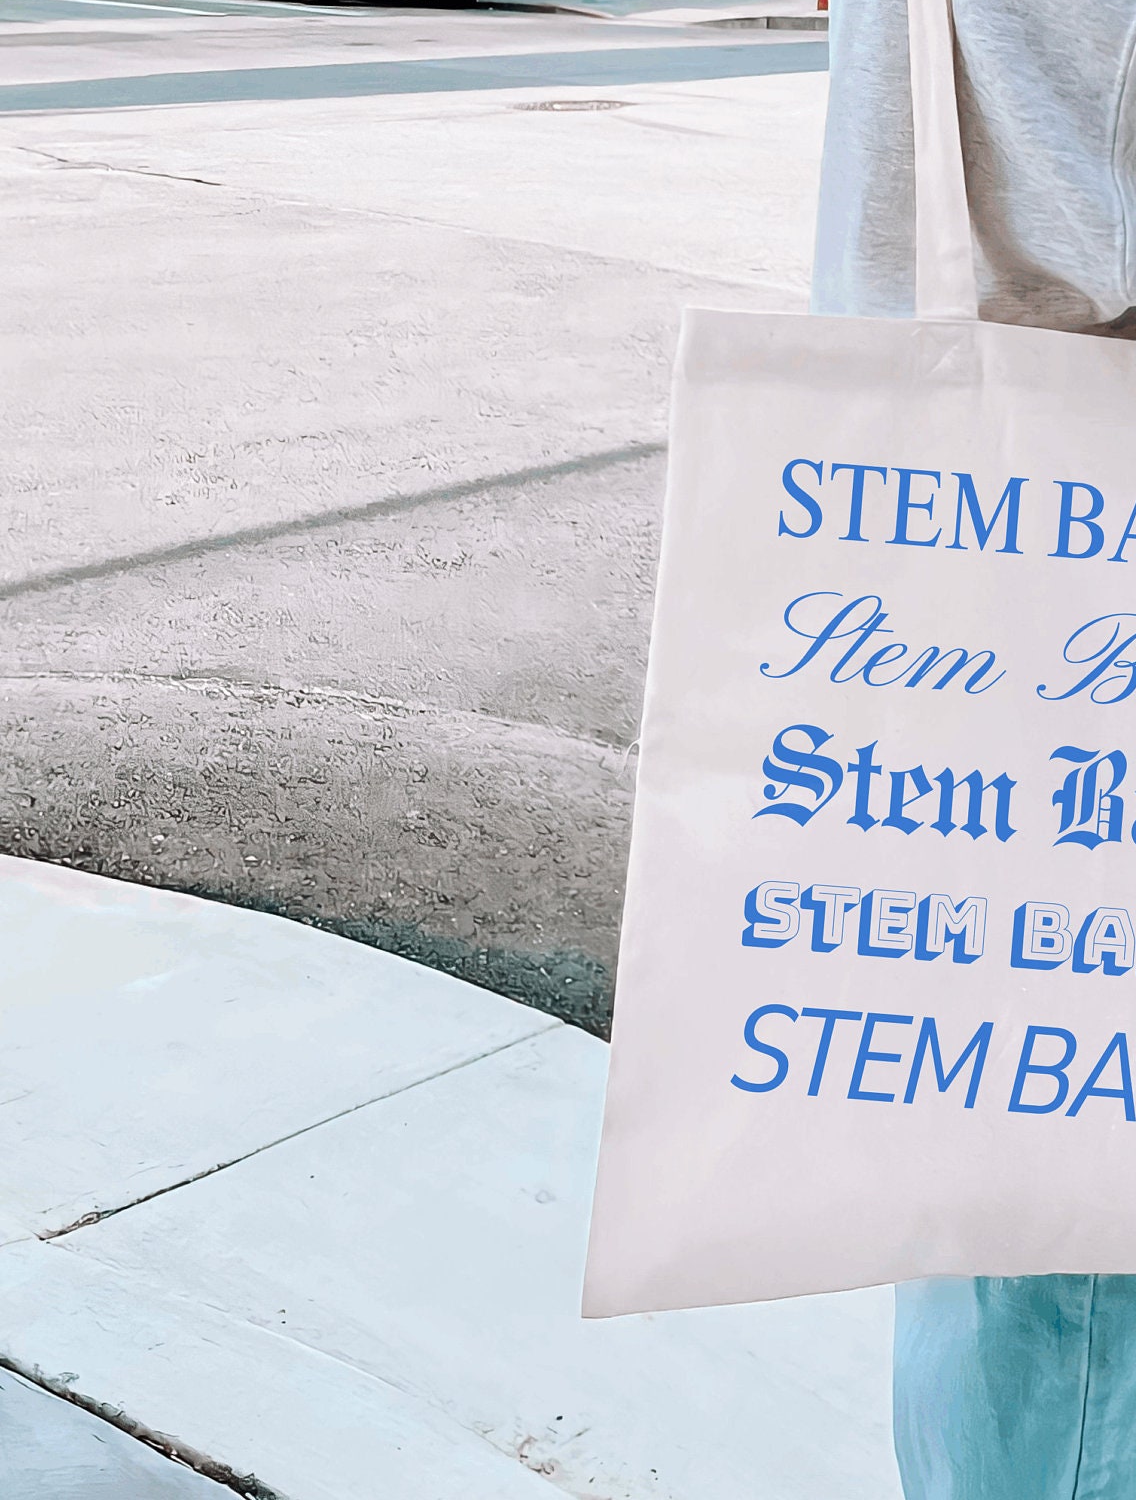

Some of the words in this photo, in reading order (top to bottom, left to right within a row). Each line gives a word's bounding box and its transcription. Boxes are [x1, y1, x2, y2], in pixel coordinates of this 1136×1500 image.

[778, 459, 1029, 555] STEM
[760, 591, 1007, 695] Stem
[752, 724, 1017, 843] Stem
[742, 880, 988, 962] STEM
[731, 1004, 995, 1109] STEM
